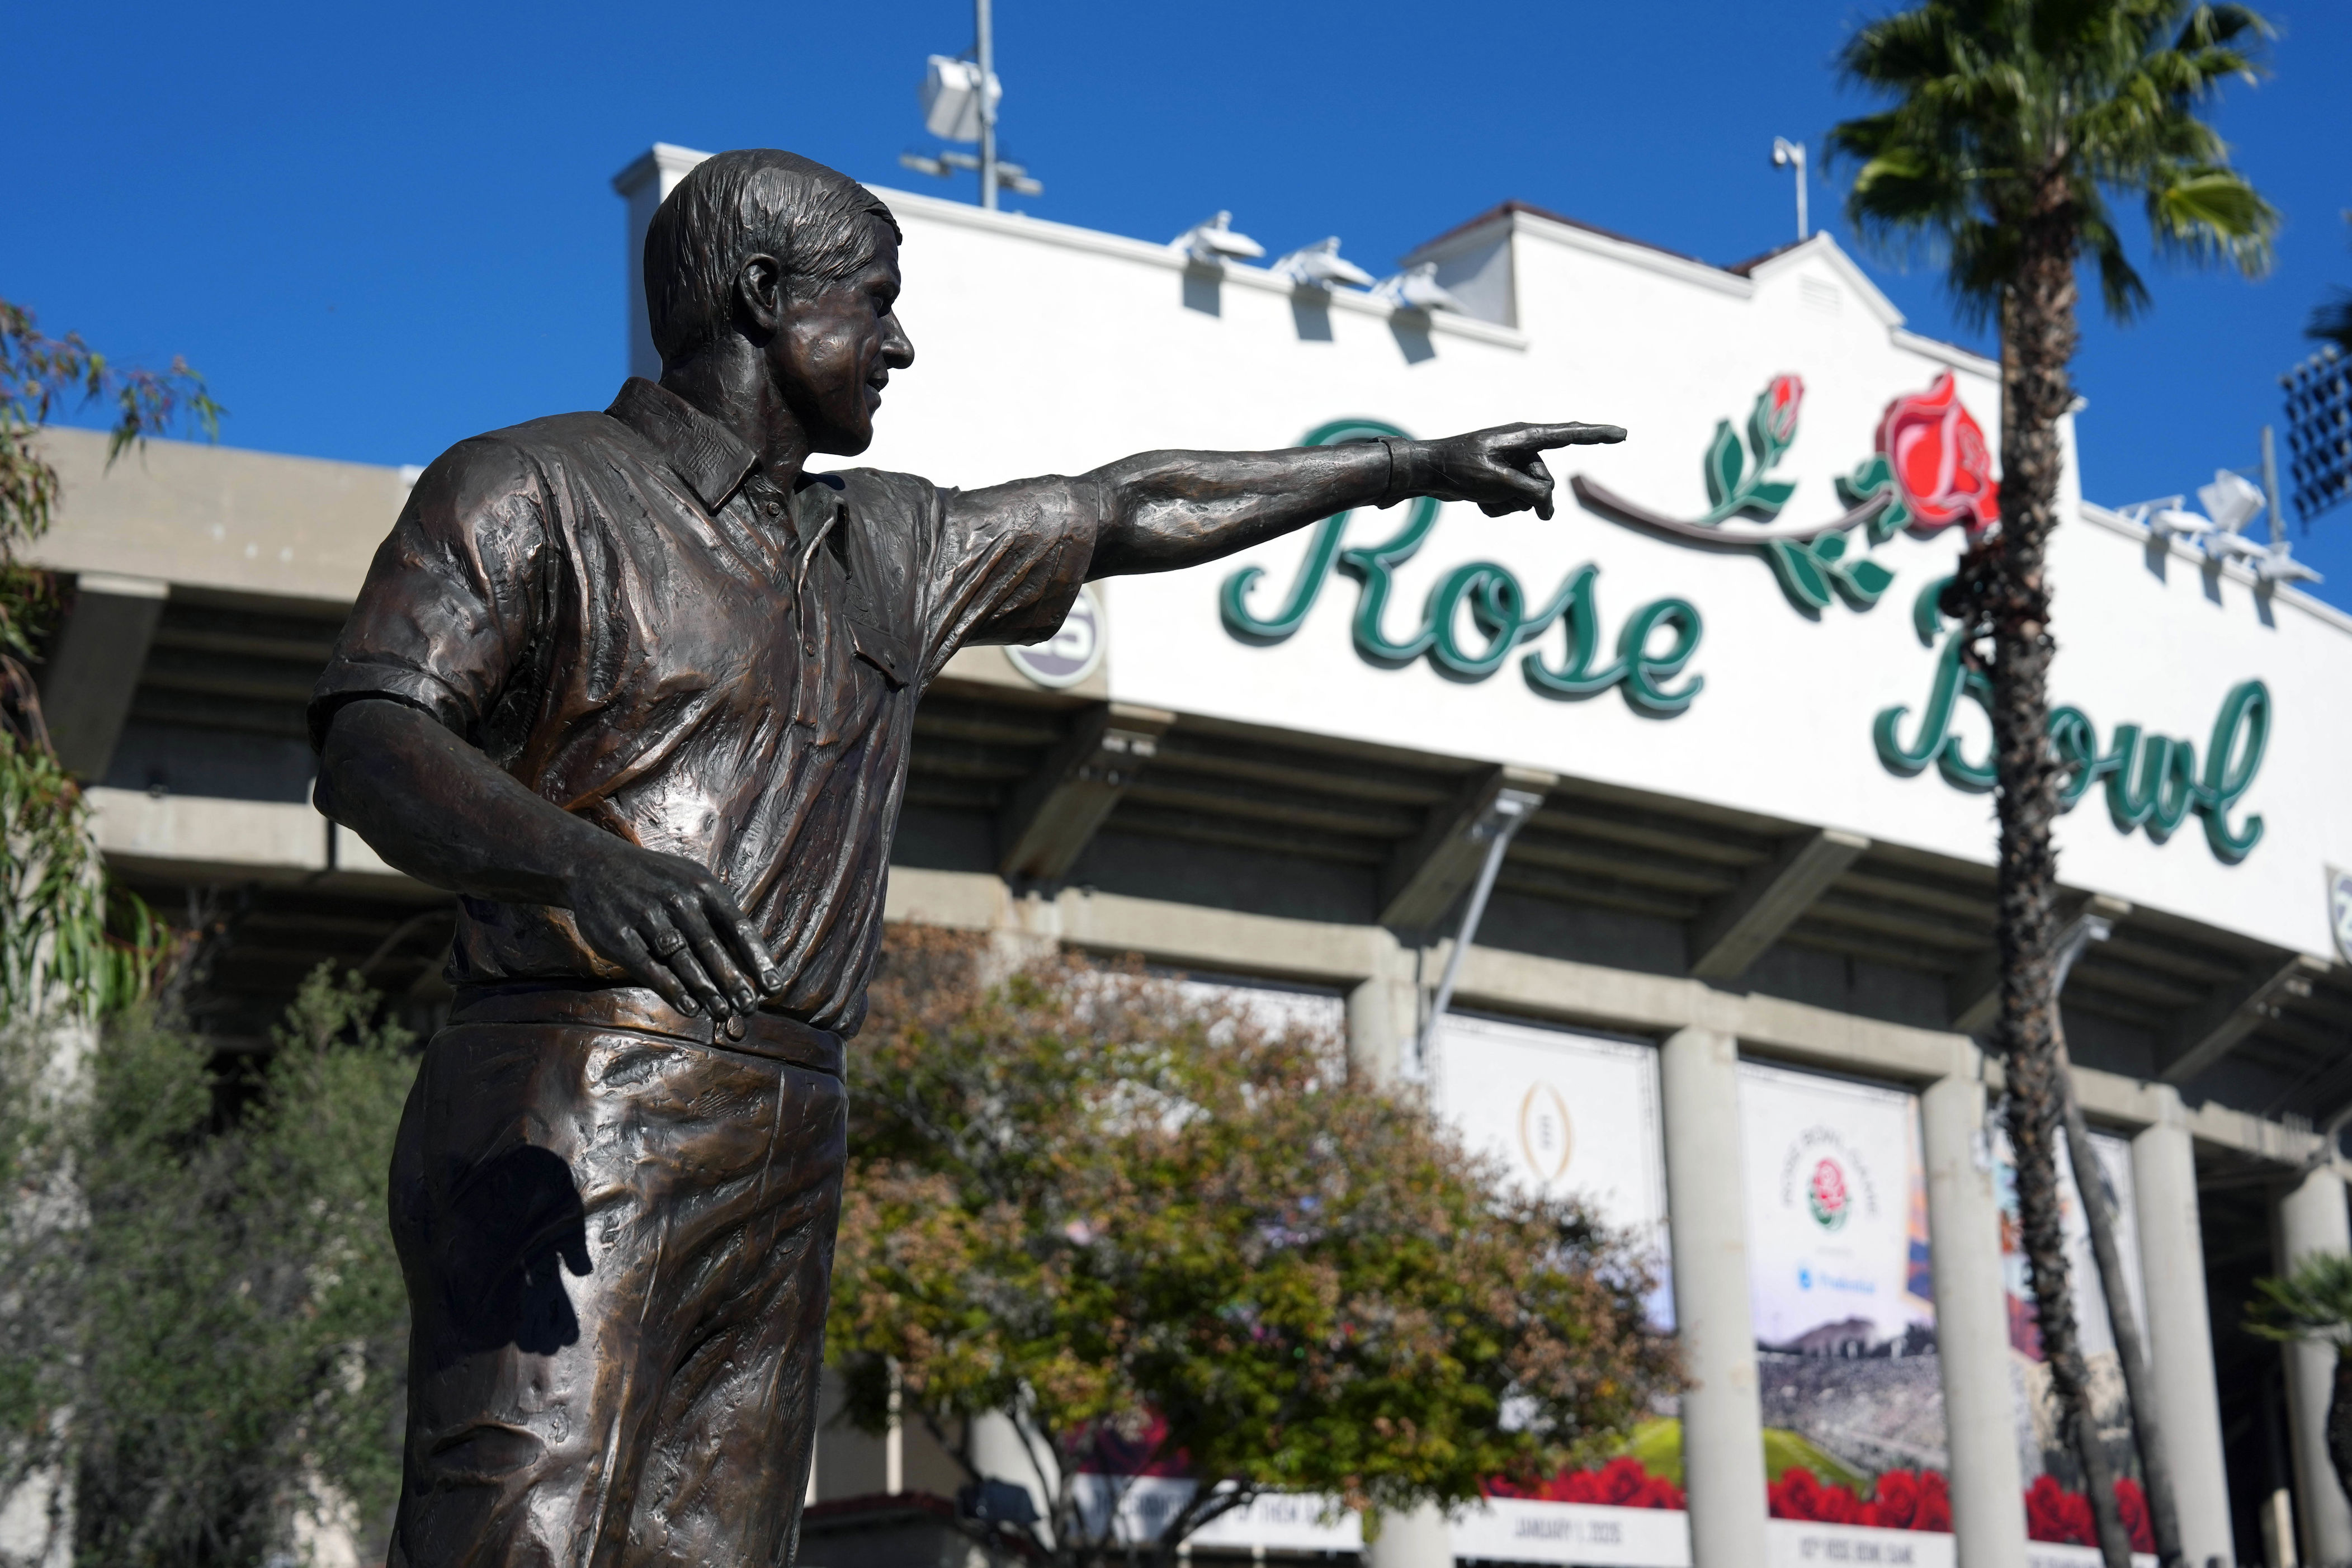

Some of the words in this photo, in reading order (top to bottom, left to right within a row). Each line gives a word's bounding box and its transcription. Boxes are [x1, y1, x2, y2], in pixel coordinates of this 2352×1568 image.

[1219, 418, 1704, 711] Rose
[1873, 575, 2271, 858] Bowl
[1514, 1517, 1570, 1541] JANUARY
